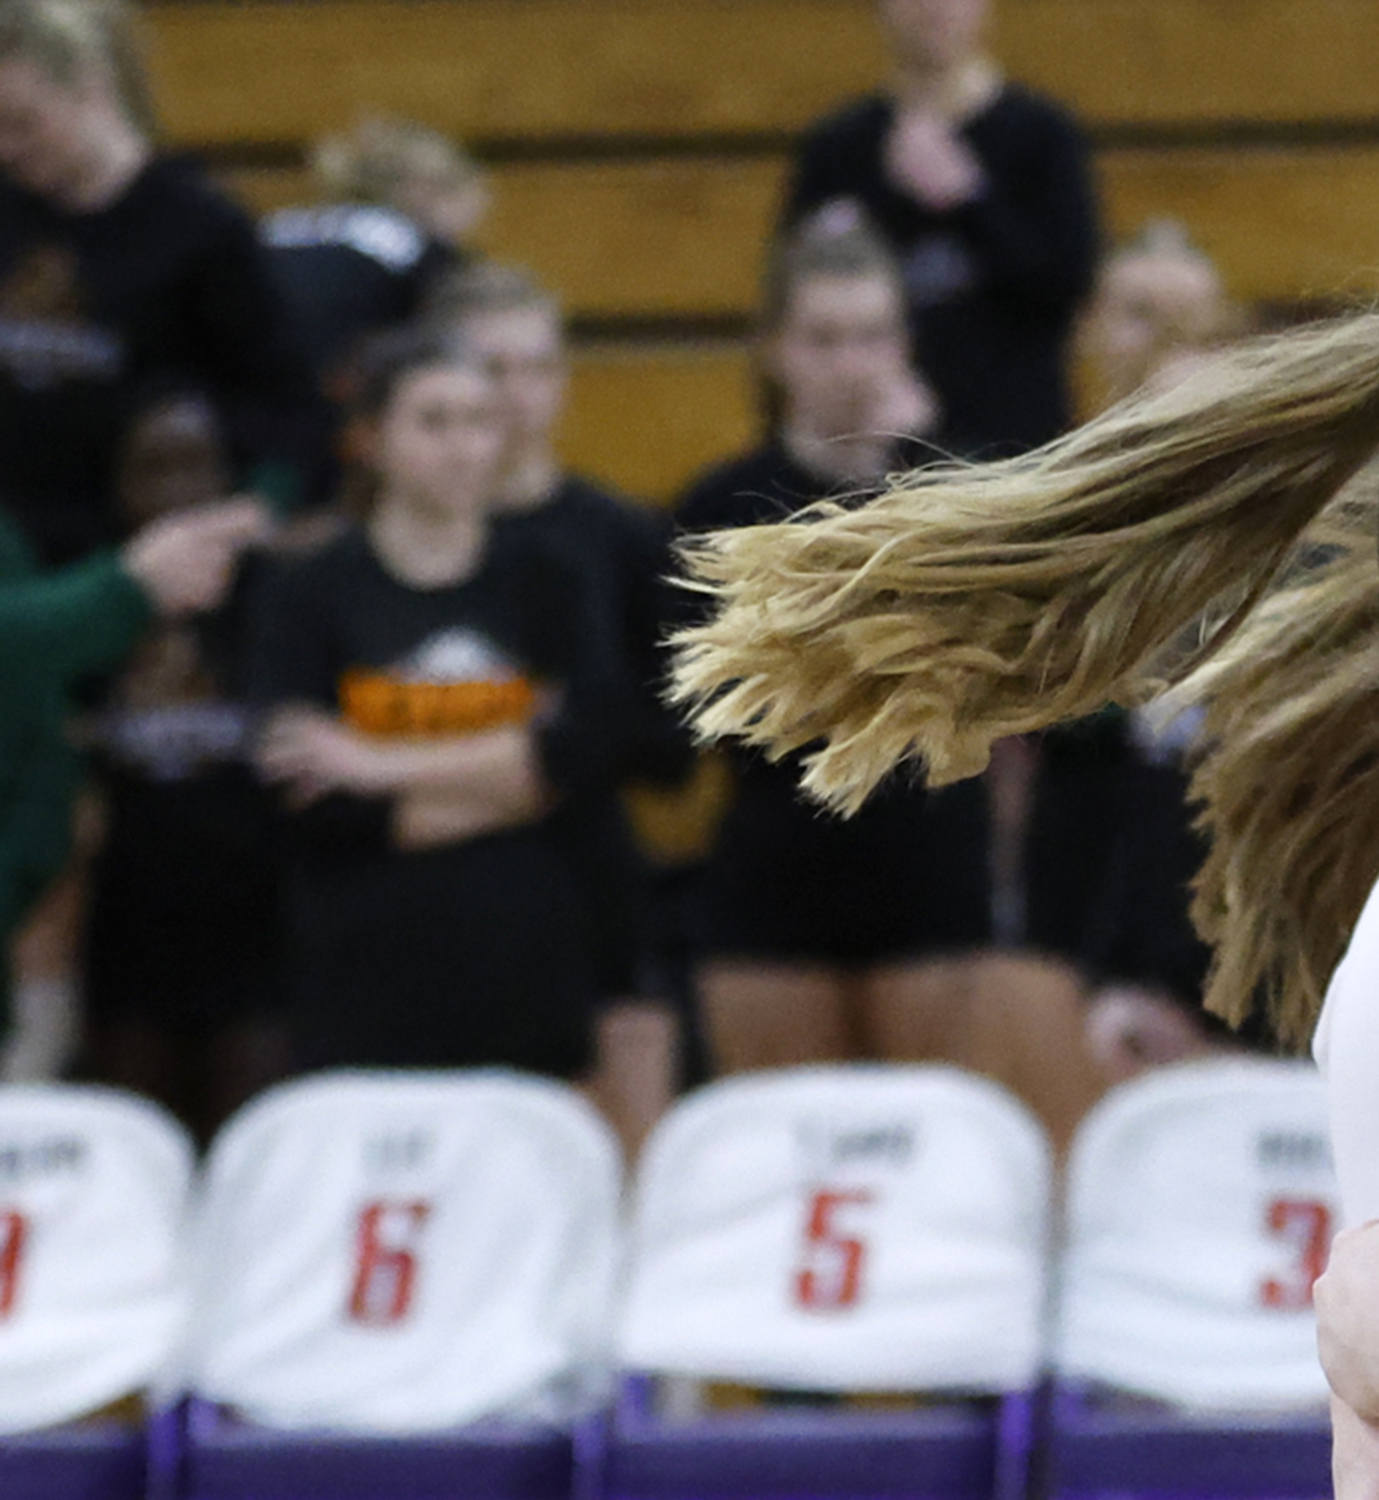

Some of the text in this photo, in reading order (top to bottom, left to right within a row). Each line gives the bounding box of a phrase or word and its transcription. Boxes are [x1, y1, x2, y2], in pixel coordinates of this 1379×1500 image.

[350, 1197, 430, 1326] 6
[794, 1186, 874, 1312] 5
[1260, 1199, 1332, 1308] 3
